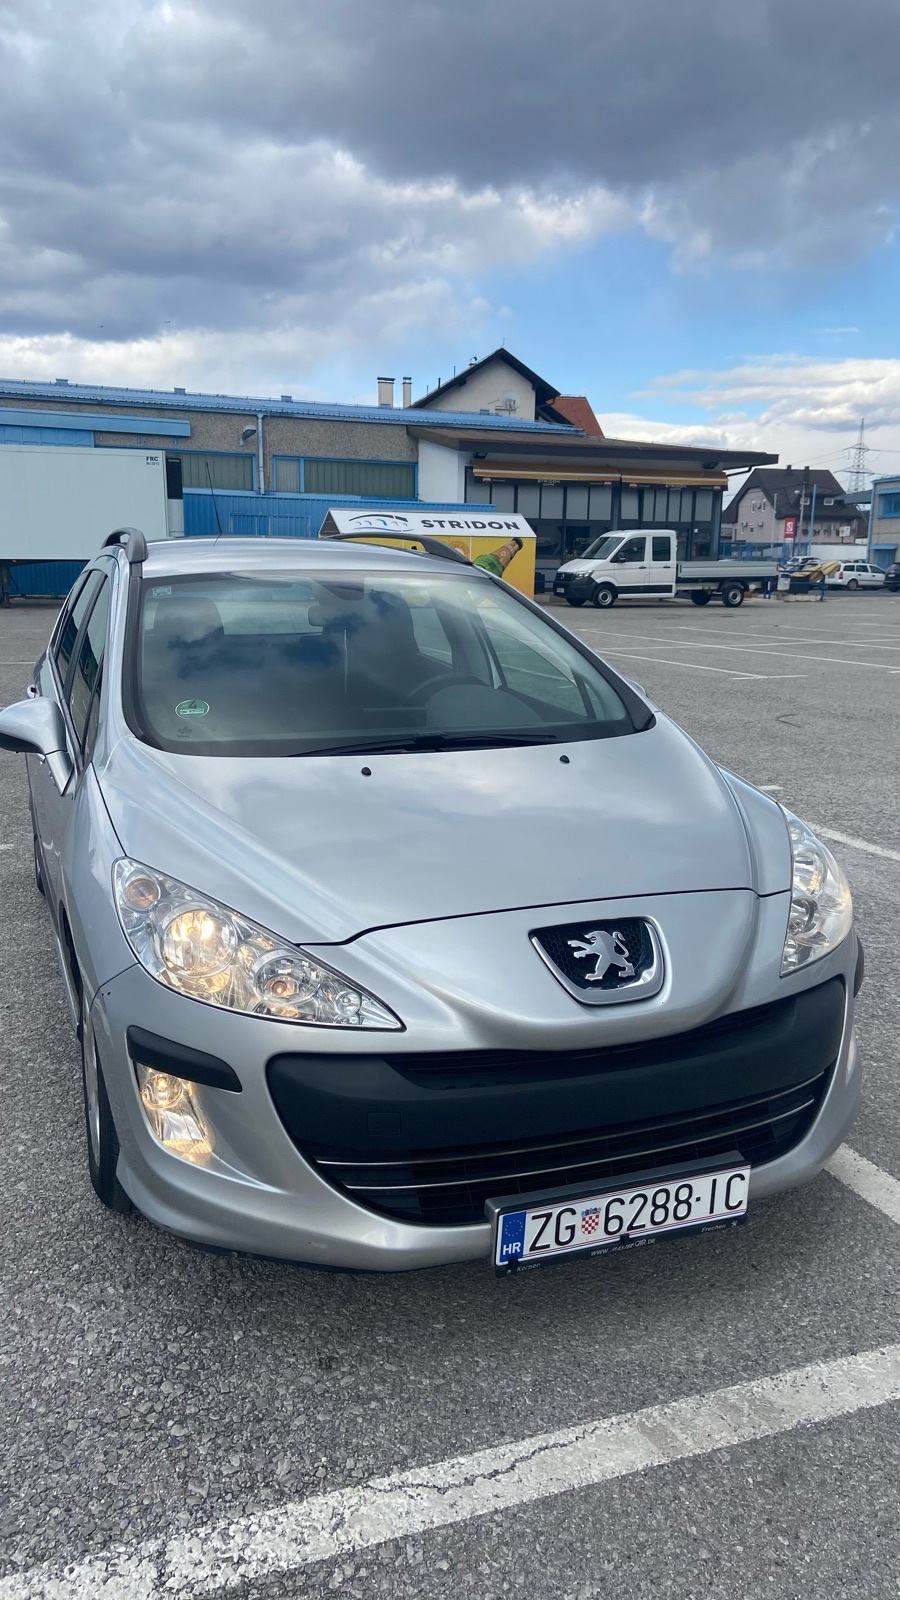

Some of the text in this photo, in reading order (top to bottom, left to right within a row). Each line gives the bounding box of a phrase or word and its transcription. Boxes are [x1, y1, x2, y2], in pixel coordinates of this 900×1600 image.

[420, 519, 520, 531] STRIDON
[529, 1207, 577, 1252] ZG
[502, 1241, 521, 1256] HR
